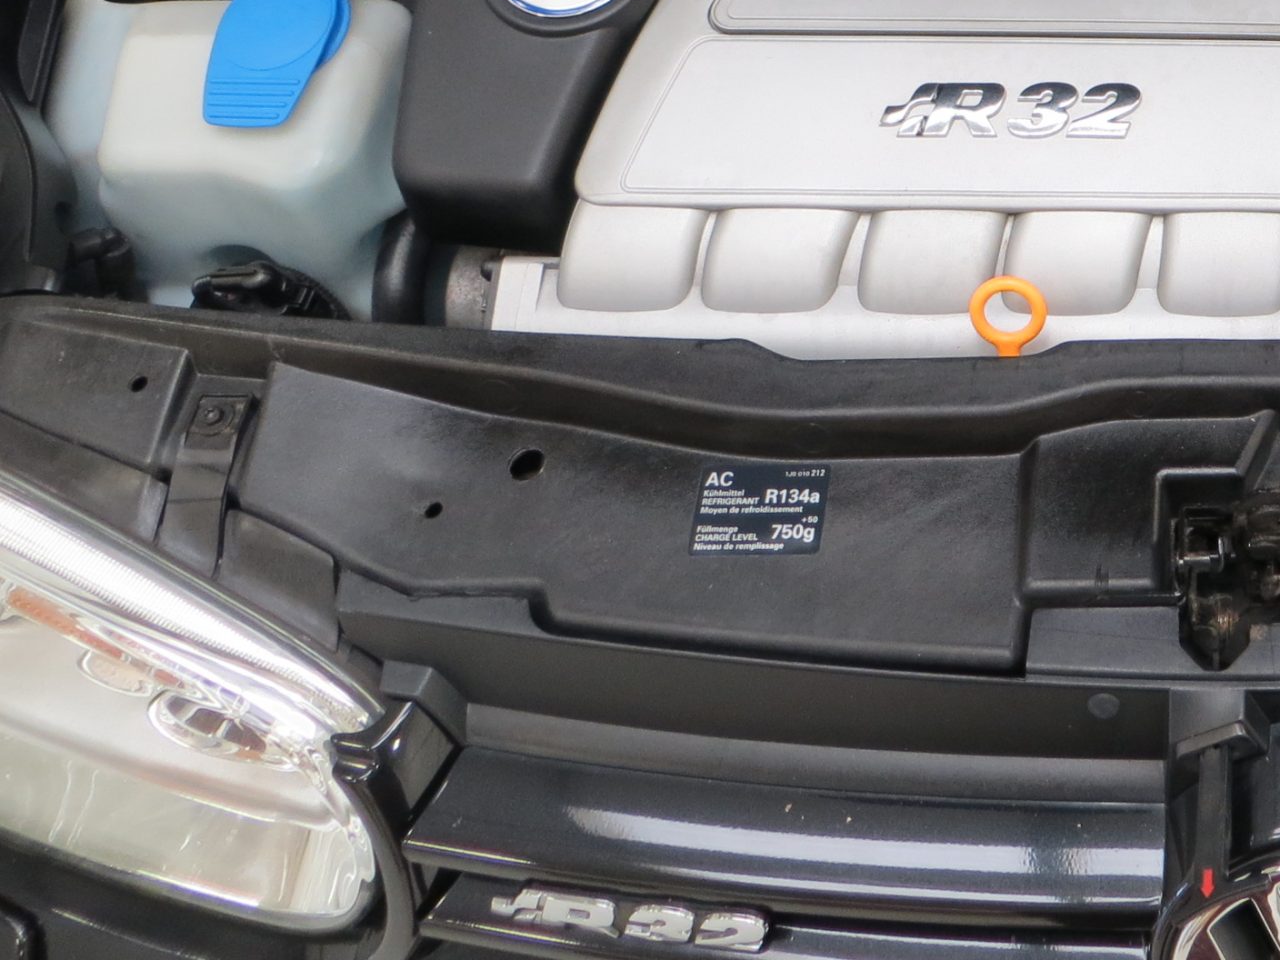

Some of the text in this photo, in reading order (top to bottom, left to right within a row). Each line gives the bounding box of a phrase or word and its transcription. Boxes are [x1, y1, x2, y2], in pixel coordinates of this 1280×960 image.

[811, 469, 825, 477] 212
[705, 471, 734, 487] AC
[703, 489, 745, 497] Kühlmittel
[764, 488, 820, 504] R134a
[702, 497, 760, 505] REFRIGERANT
[700, 506, 728, 515] Moyen
[741, 505, 803, 513] refroidissement
[696, 525, 739, 533] Füllmenge
[695, 533, 758, 541] CHARGE LEVEL
[771, 524, 815, 543] 750g
[693, 543, 722, 551] Niveau
[735, 542, 785, 551] remplissage
